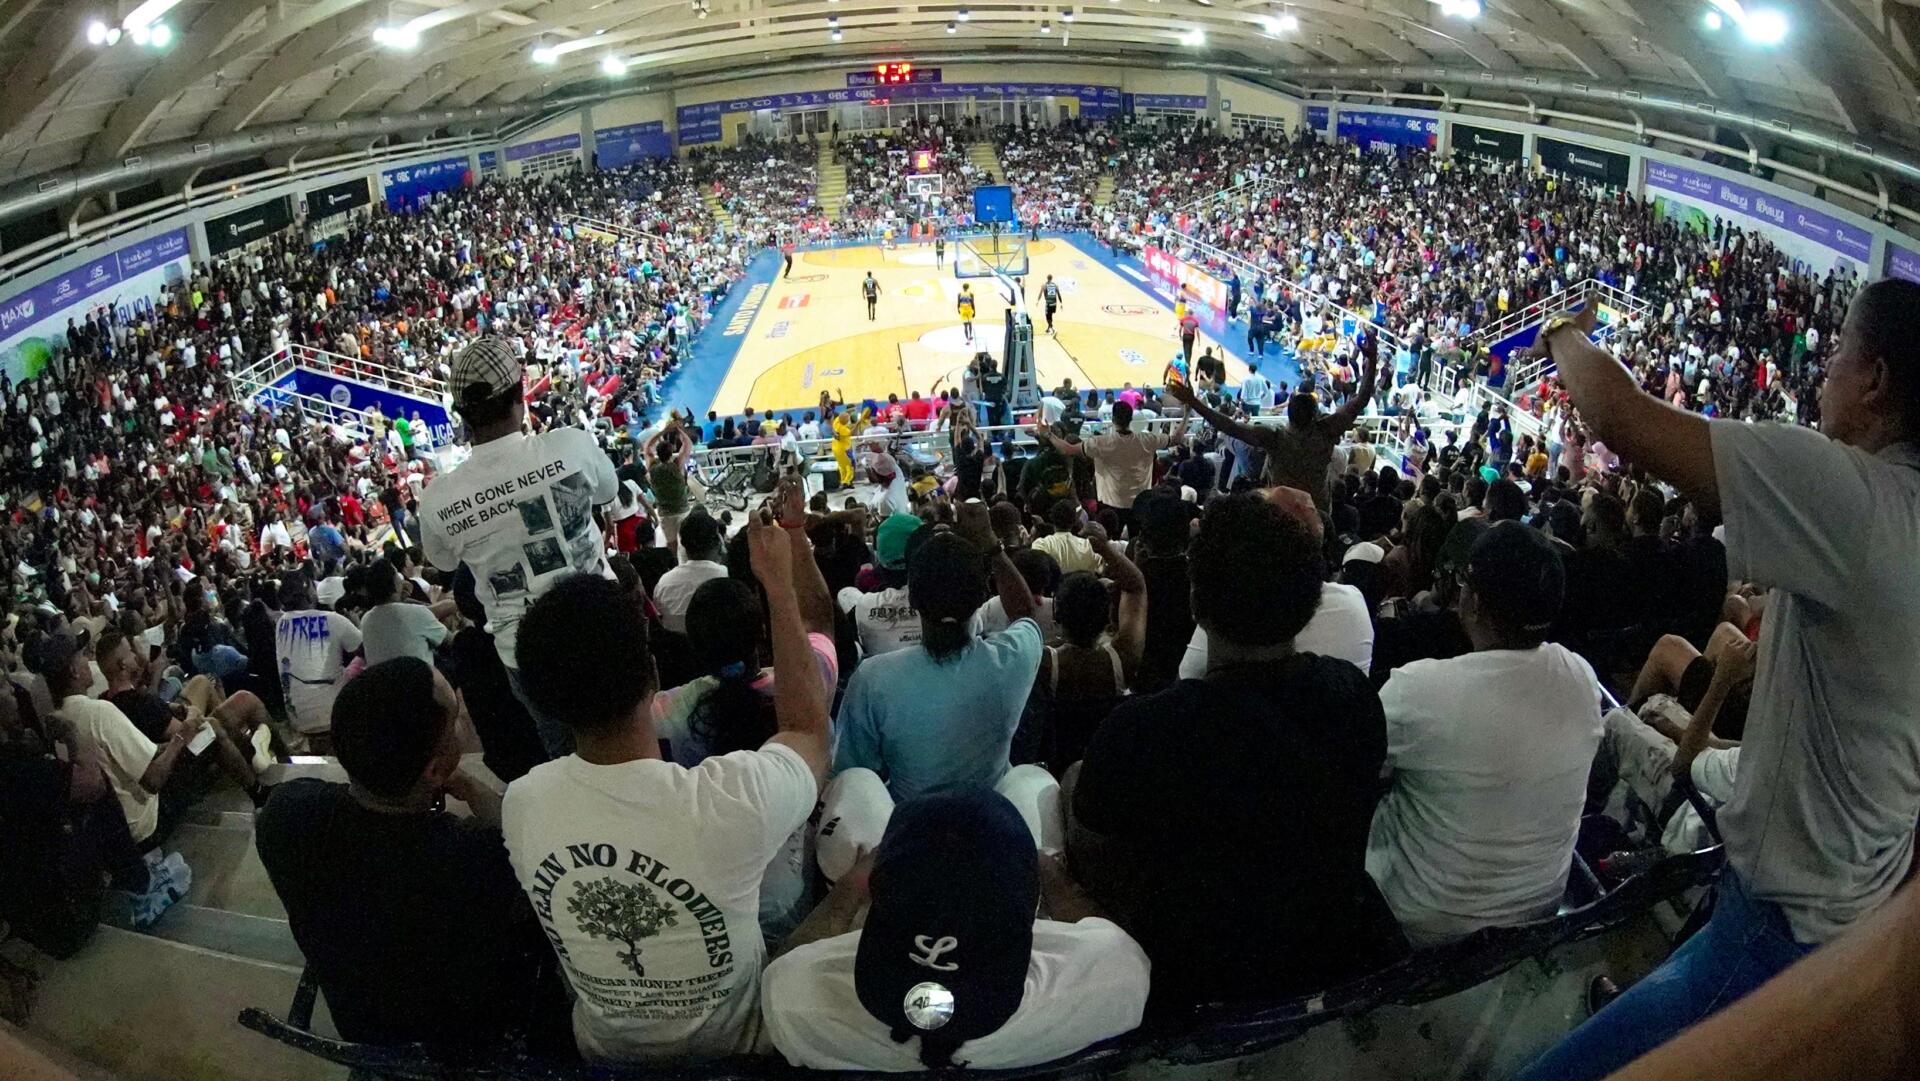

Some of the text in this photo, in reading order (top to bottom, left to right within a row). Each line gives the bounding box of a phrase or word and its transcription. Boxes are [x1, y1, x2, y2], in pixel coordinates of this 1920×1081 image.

[437, 459, 566, 522] WHEN GONE NEVER
[446, 499, 520, 537] COME BACK
[291, 616, 330, 642] FREE
[565, 843, 617, 868] NO
[625, 849, 734, 968] FLOWERS
[630, 978, 683, 989] MONEY
[685, 966, 734, 986] TREES
